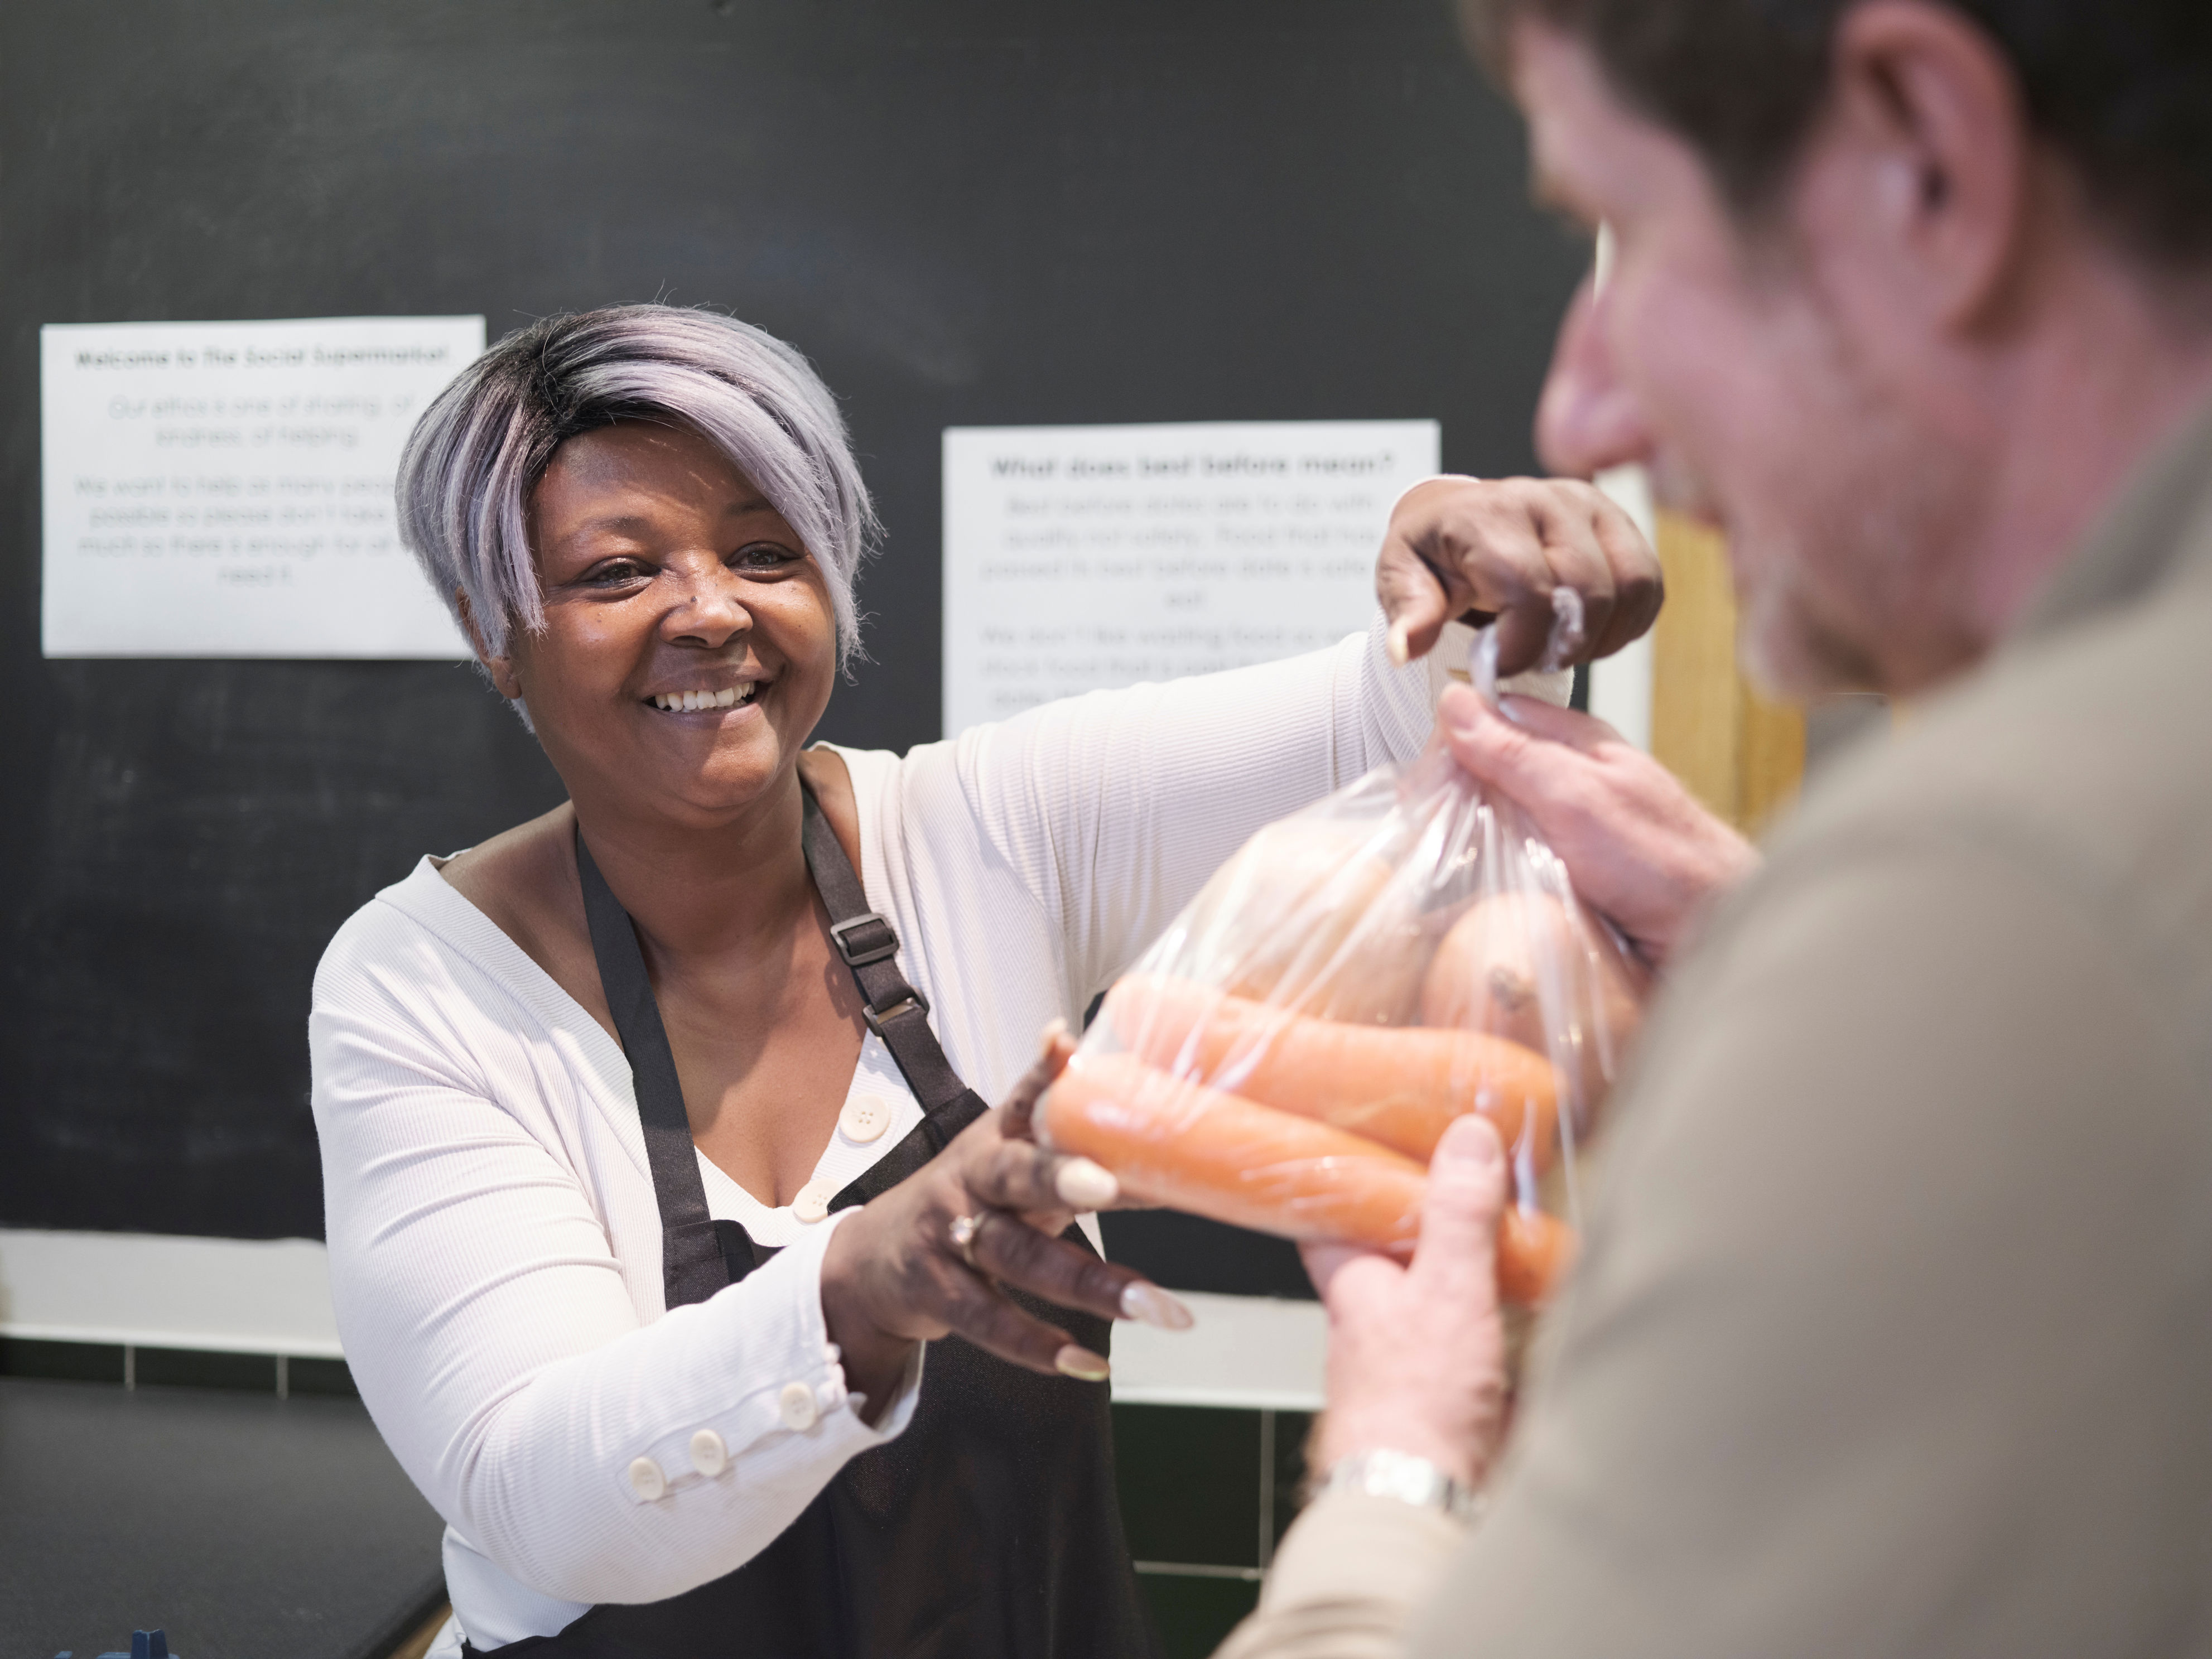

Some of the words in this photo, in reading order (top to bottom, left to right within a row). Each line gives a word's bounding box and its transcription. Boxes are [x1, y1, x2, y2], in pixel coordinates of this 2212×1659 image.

[74, 346, 172, 369] Welcome
[175, 346, 197, 367] to
[244, 345, 307, 366] Social
[310, 343, 450, 371] Supermarket
[991, 454, 1058, 478] What
[1065, 452, 1131, 478] does
[1138, 452, 1194, 476] best
[1202, 450, 1292, 475] before
[1299, 448, 1397, 475] mean?
